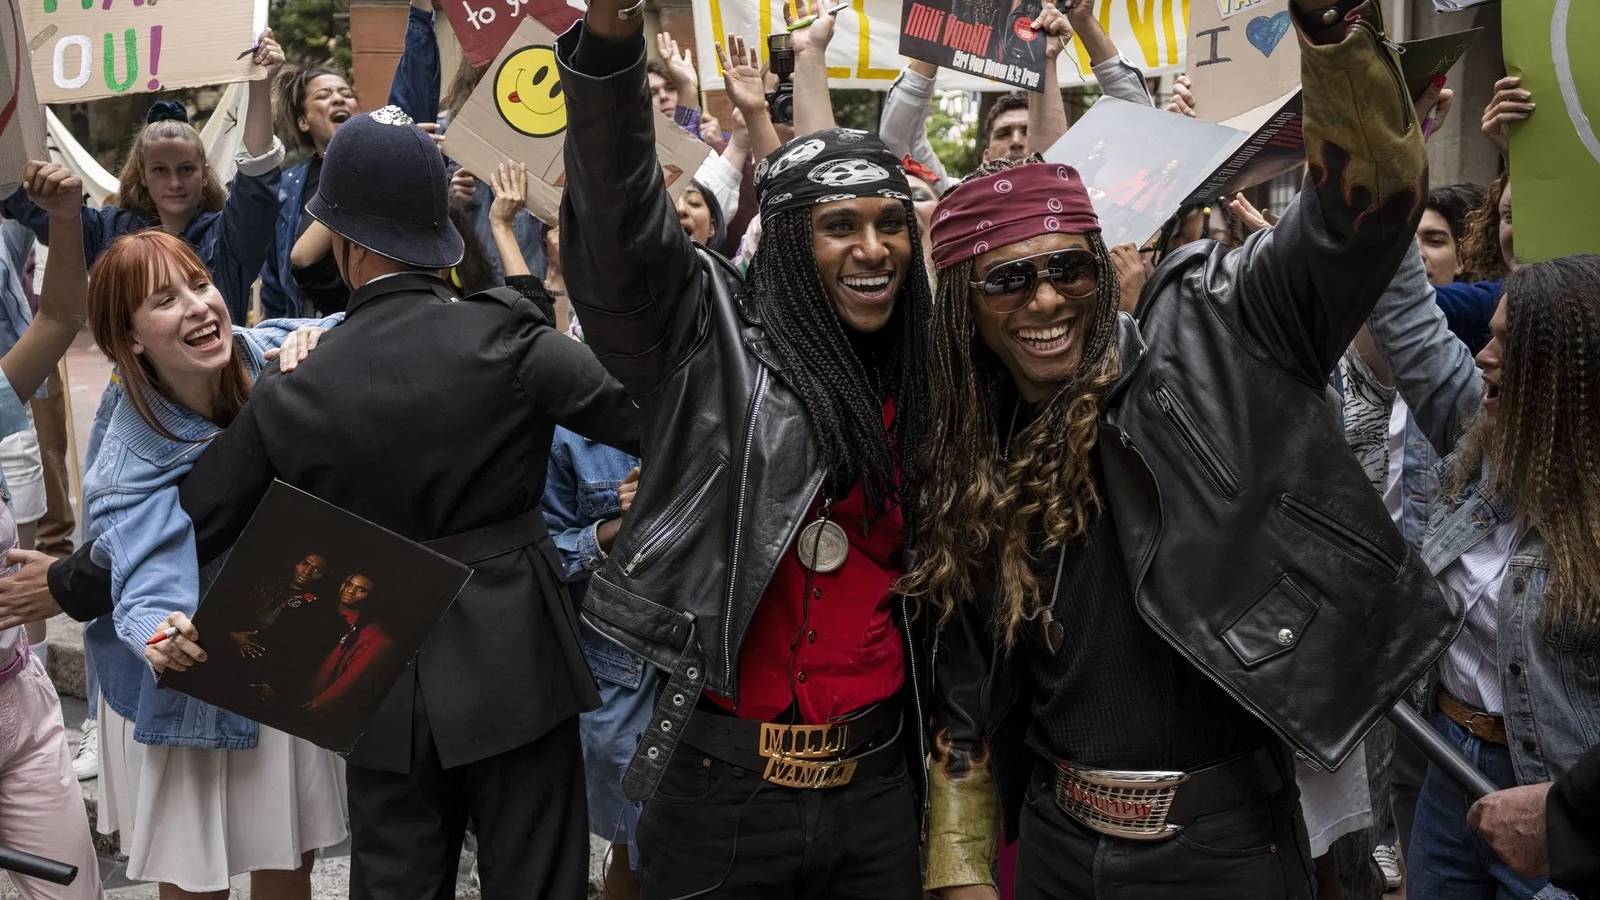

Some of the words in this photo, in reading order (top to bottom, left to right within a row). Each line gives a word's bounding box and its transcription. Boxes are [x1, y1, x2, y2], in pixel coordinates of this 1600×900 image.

[462, 1, 496, 30] to
[904, 2, 946, 43] Milli
[942, 14, 993, 57] Vanilli
[29, 24, 163, 92] OU!
[1196, 26, 1232, 67] I
[952, 50, 969, 70] Girl
[968, 56, 985, 74] You
[984, 59, 1009, 80] Know
[1019, 67, 1041, 88] True
